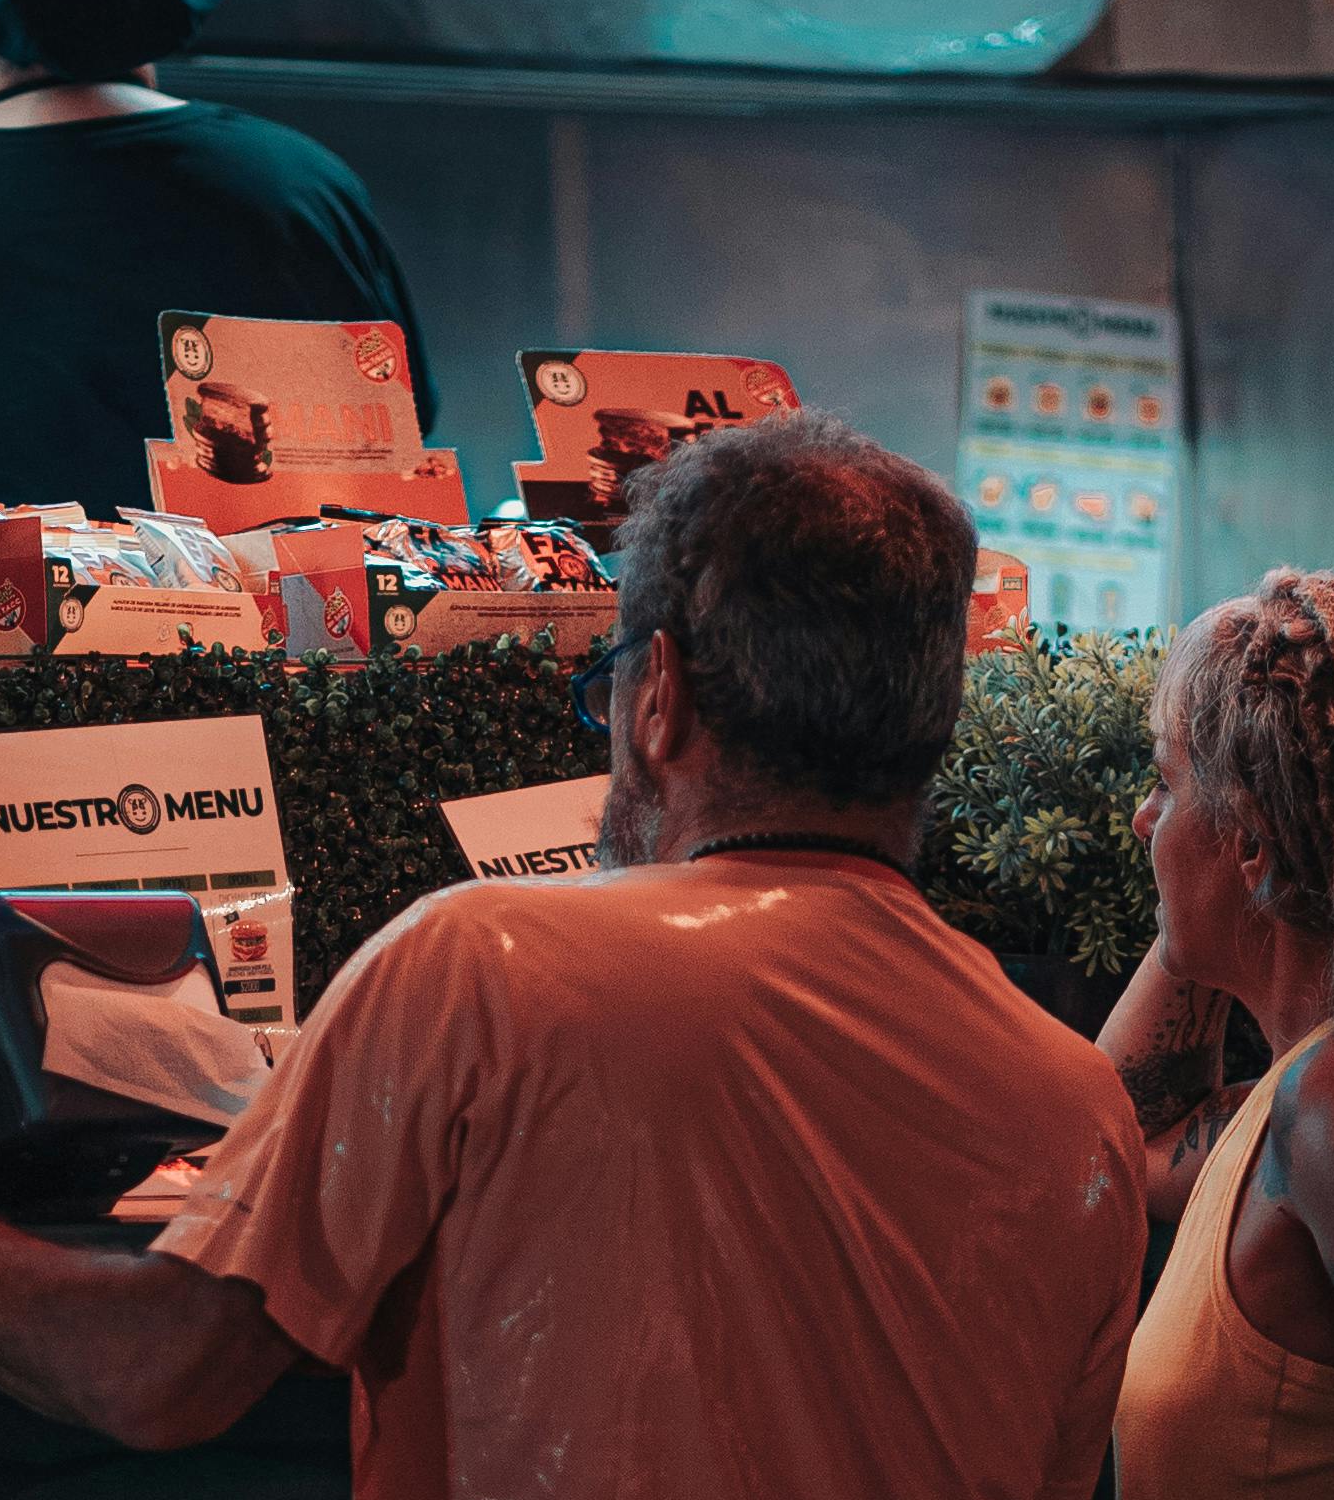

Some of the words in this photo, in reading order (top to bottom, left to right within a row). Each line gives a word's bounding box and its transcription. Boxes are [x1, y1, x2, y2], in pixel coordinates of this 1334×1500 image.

[685, 390, 743, 419] AL
[51, 565, 70, 583] 12
[376, 574, 397, 591] 12
[163, 787, 264, 822] MENU
